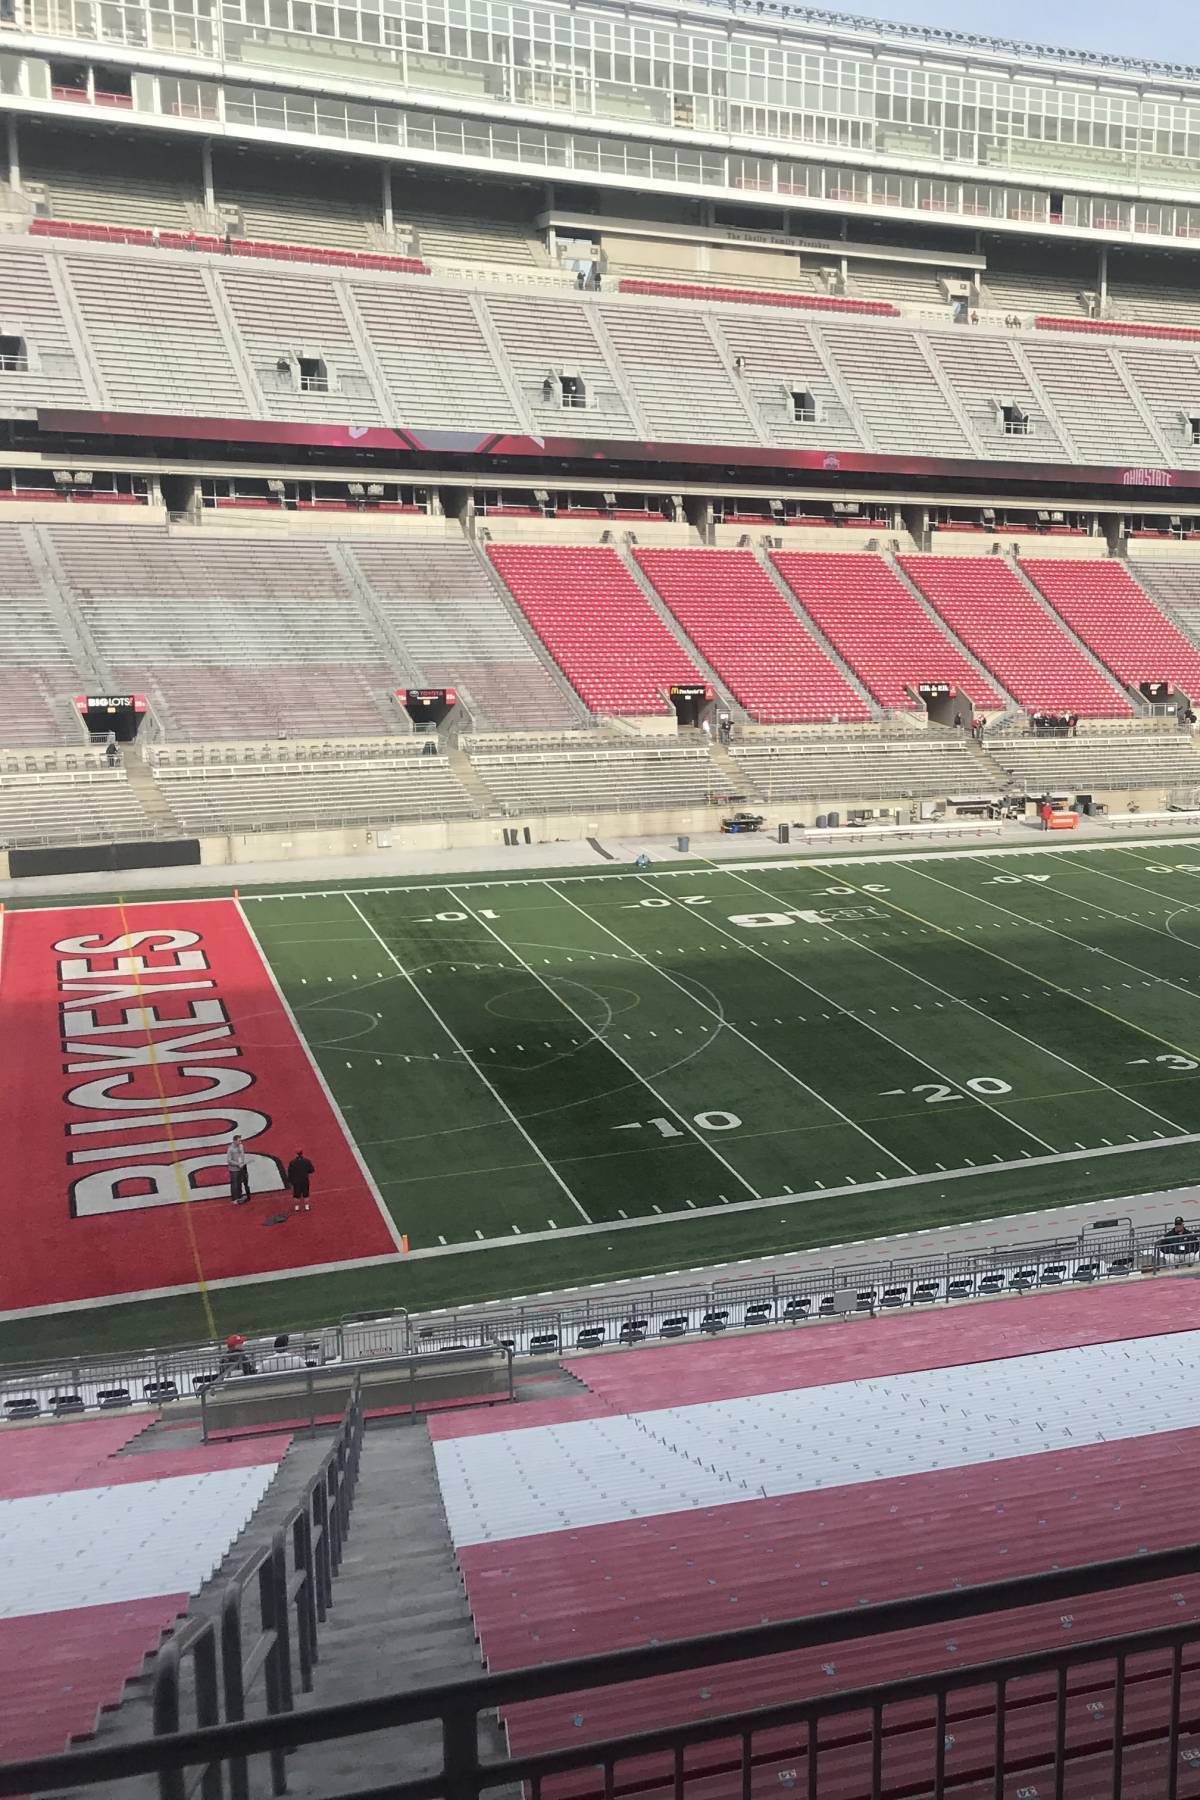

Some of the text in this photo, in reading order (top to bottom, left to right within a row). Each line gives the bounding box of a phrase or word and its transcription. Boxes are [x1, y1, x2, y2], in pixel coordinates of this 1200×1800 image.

[50, 928, 290, 1218] BUCKEYES
[910, 1076, 1013, 1104] 20
[644, 1110, 744, 1139] 10
